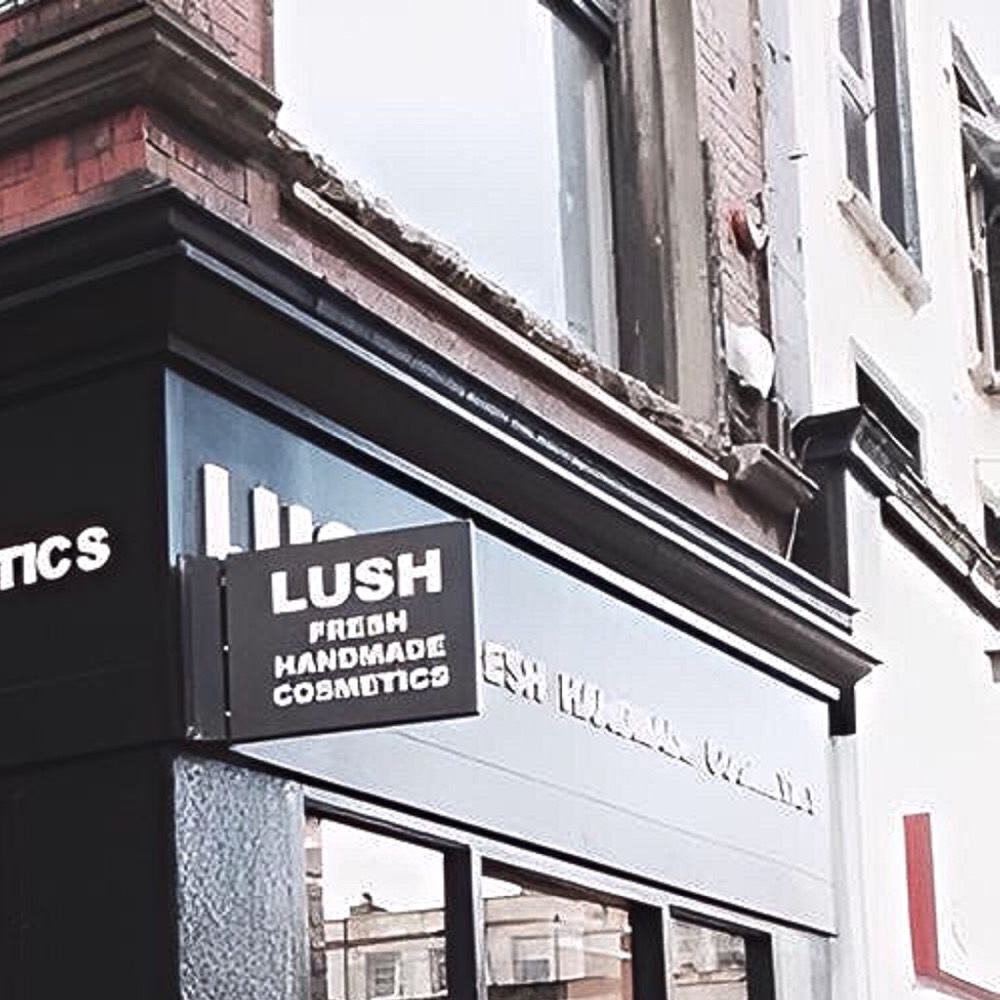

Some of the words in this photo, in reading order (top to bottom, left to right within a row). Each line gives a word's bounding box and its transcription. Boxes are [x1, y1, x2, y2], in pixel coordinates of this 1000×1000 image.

[271, 548, 443, 615] LUSH
[309, 609, 408, 645] FRESH
[275, 634, 447, 679] HANDMADE
[273, 665, 451, 707] COSMETICS
